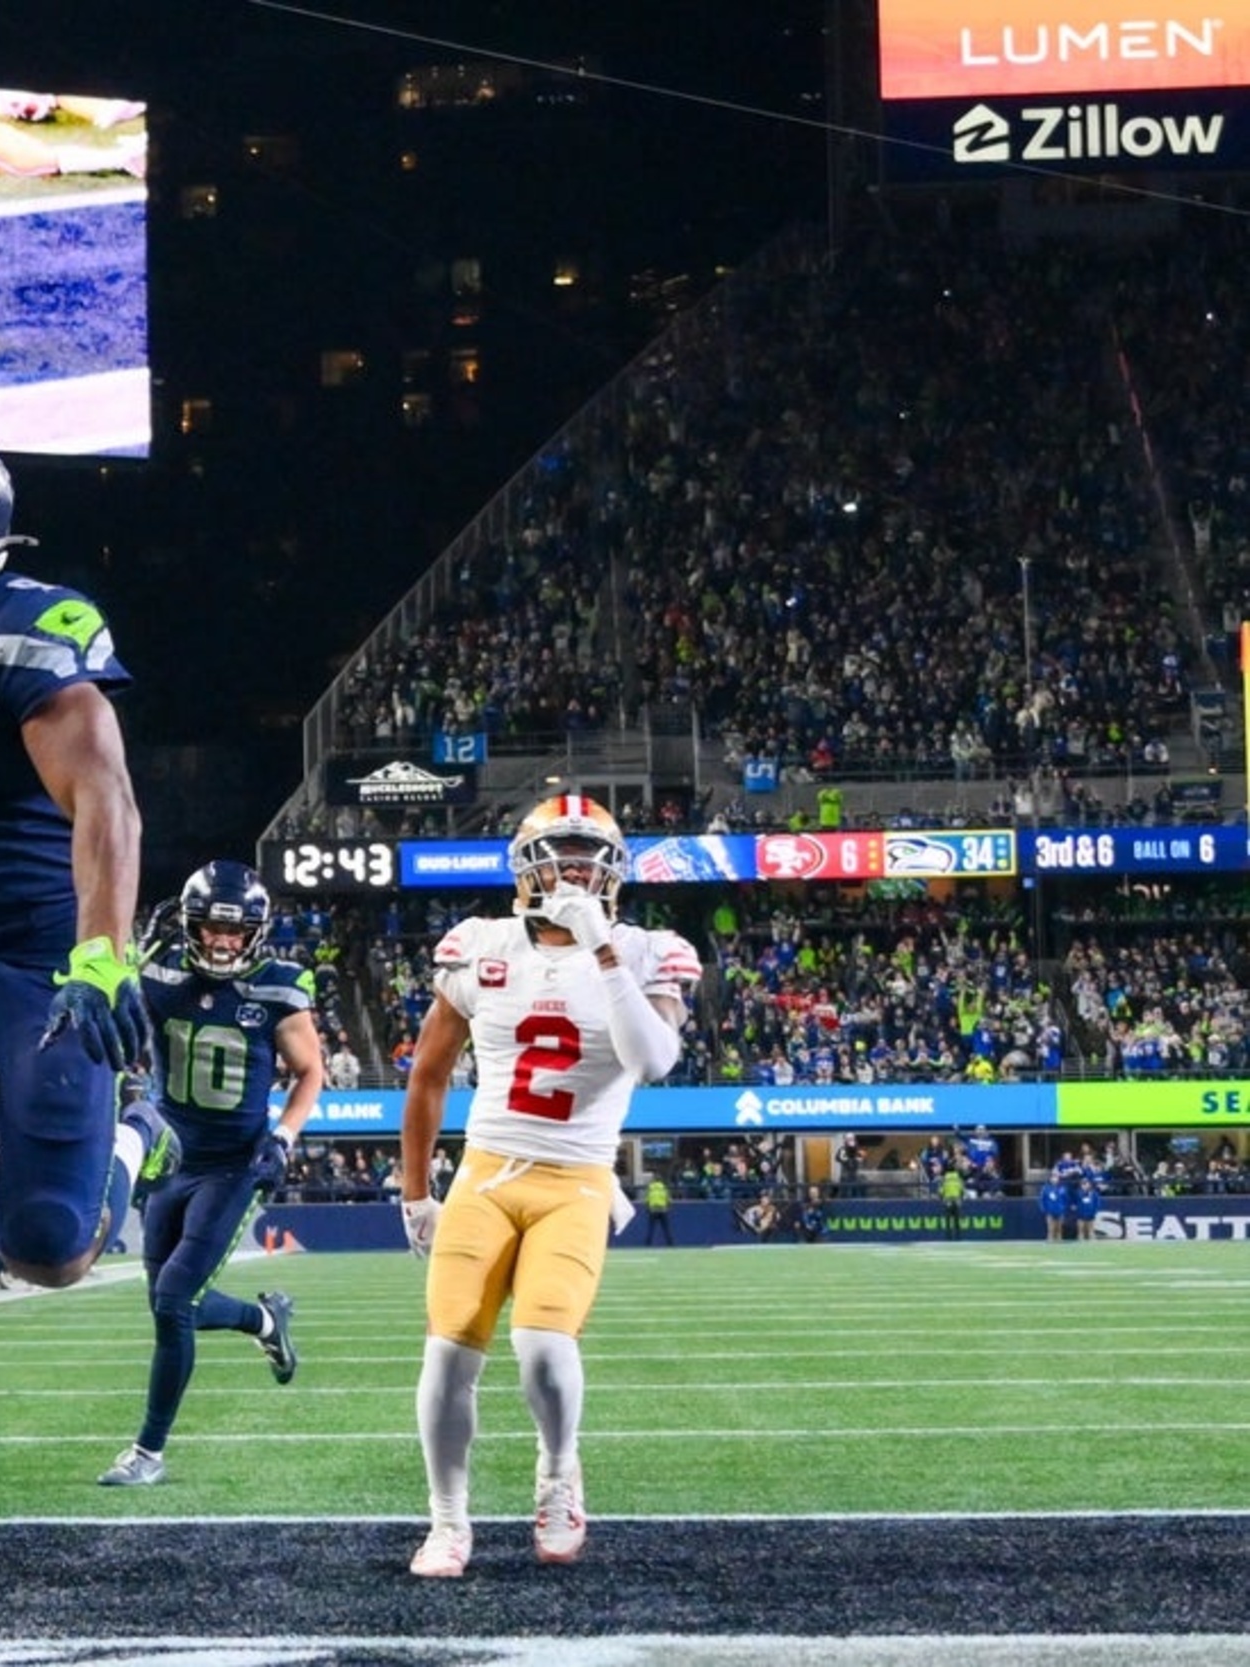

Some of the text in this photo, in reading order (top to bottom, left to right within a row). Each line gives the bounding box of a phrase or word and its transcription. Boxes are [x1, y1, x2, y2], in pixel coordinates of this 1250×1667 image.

[1021, 104, 1224, 160] Zillow
[443, 735, 476, 763] 12
[284, 843, 393, 887] 12:43
[417, 856, 499, 870] BUD LIGHT
[840, 839, 858, 873] 6
[961, 837, 994, 870] 34
[1036, 834, 1115, 868] 3rd & 6
[1132, 834, 1216, 863] BALL ON 6
[164, 1017, 248, 1110] 10
[507, 1014, 582, 1122] 2
[326, 1102, 384, 1120] BANK
[766, 1097, 935, 1115] COLUMBIA BANK
[1201, 1090, 1250, 1114] SE
